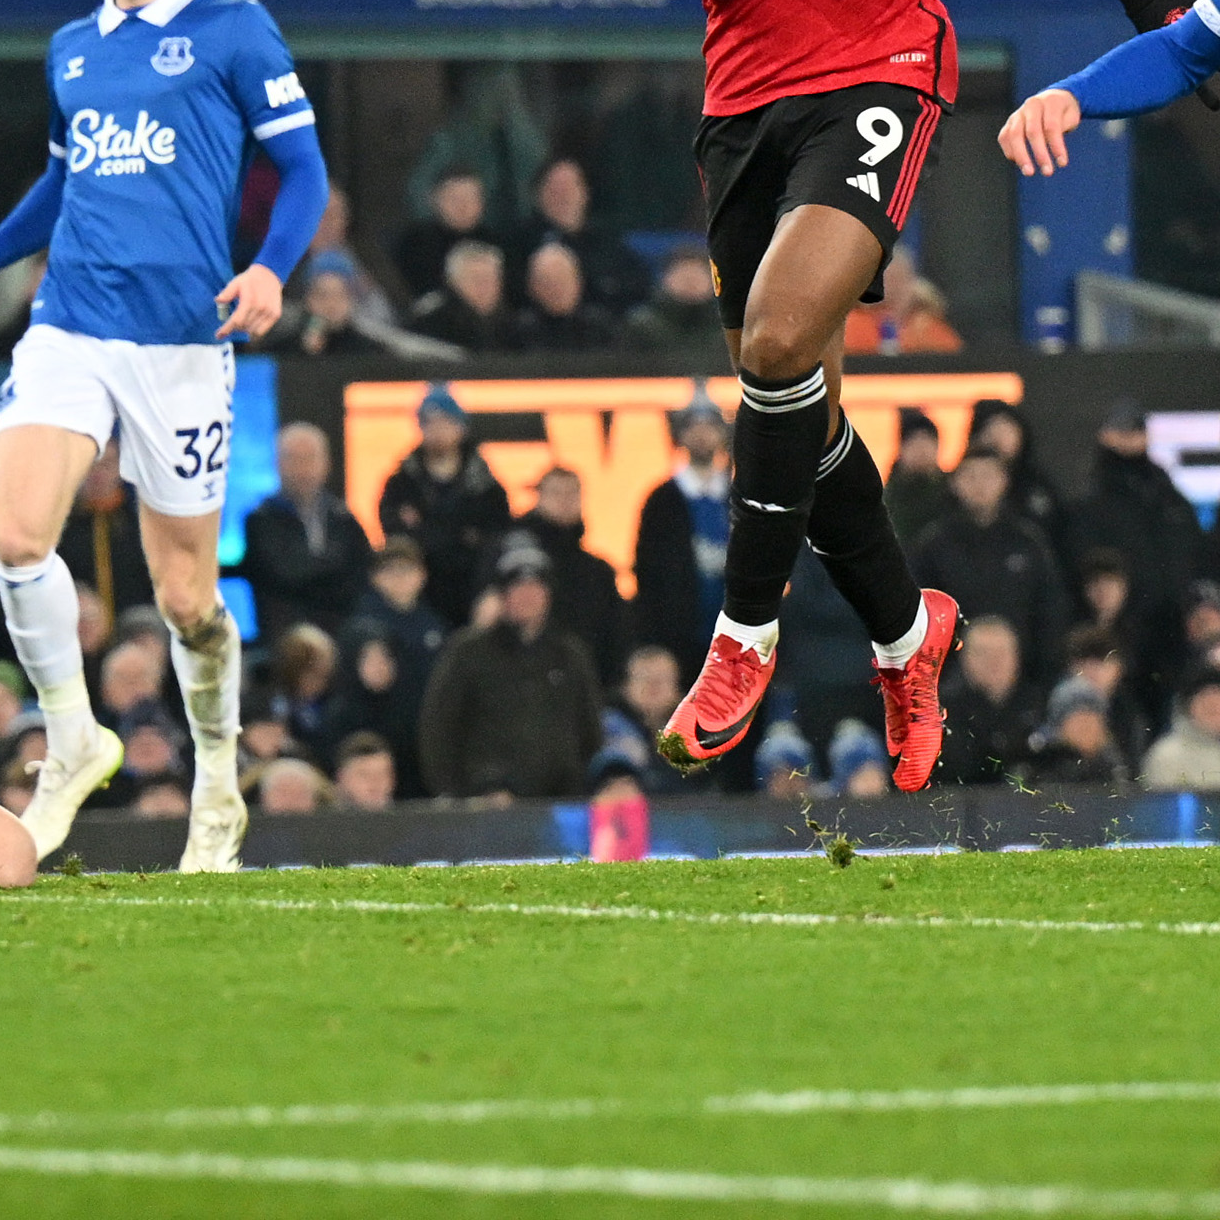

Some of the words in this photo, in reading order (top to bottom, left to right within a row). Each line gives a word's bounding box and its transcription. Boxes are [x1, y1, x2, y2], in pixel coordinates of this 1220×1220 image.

[70, 108, 177, 173] Stake
[856, 106, 904, 167] 9
[95, 157, 146, 177] .com
[174, 421, 223, 479] 32
